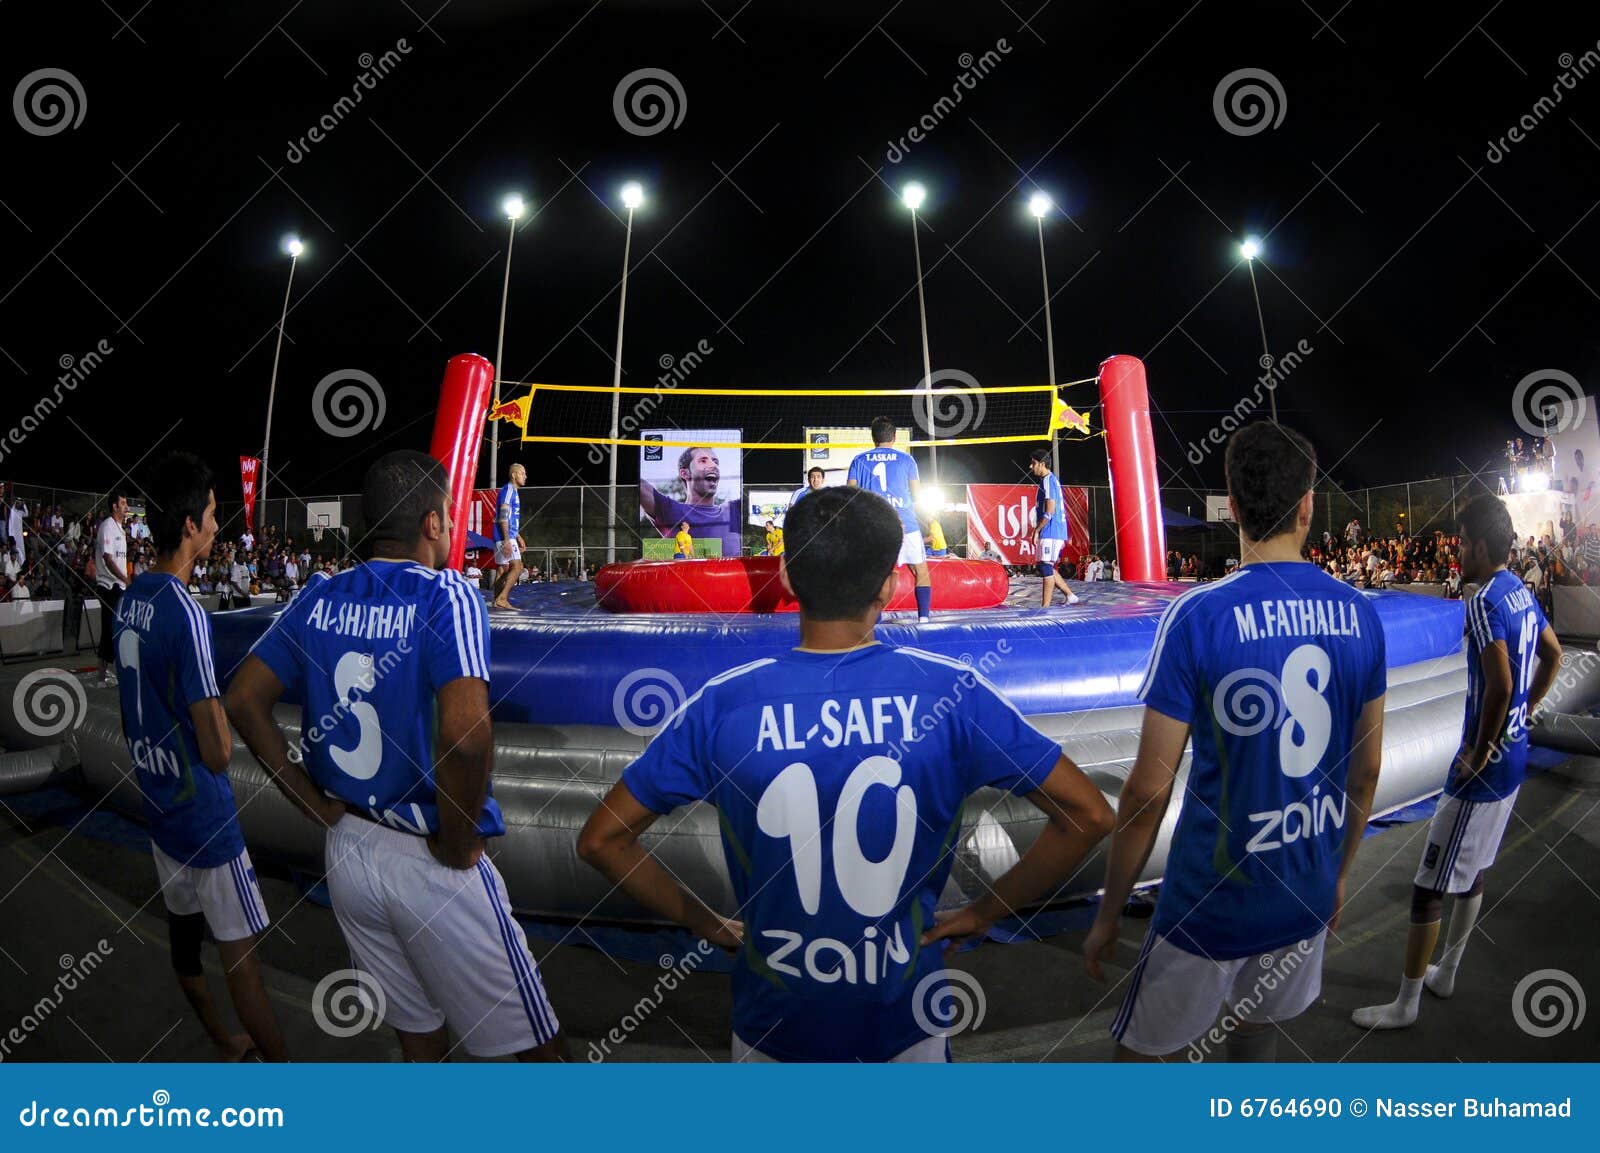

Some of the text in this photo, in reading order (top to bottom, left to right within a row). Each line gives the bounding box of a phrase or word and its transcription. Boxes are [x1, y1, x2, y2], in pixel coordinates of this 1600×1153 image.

[866, 453, 897, 462] T.ASKAR
[872, 461, 887, 492] 1
[1233, 598, 1361, 644] M.FATHALLA
[329, 651, 383, 780] 5
[756, 694, 918, 752] AL-SAFY
[1278, 643, 1333, 778] 8
[756, 755, 918, 918] 10
